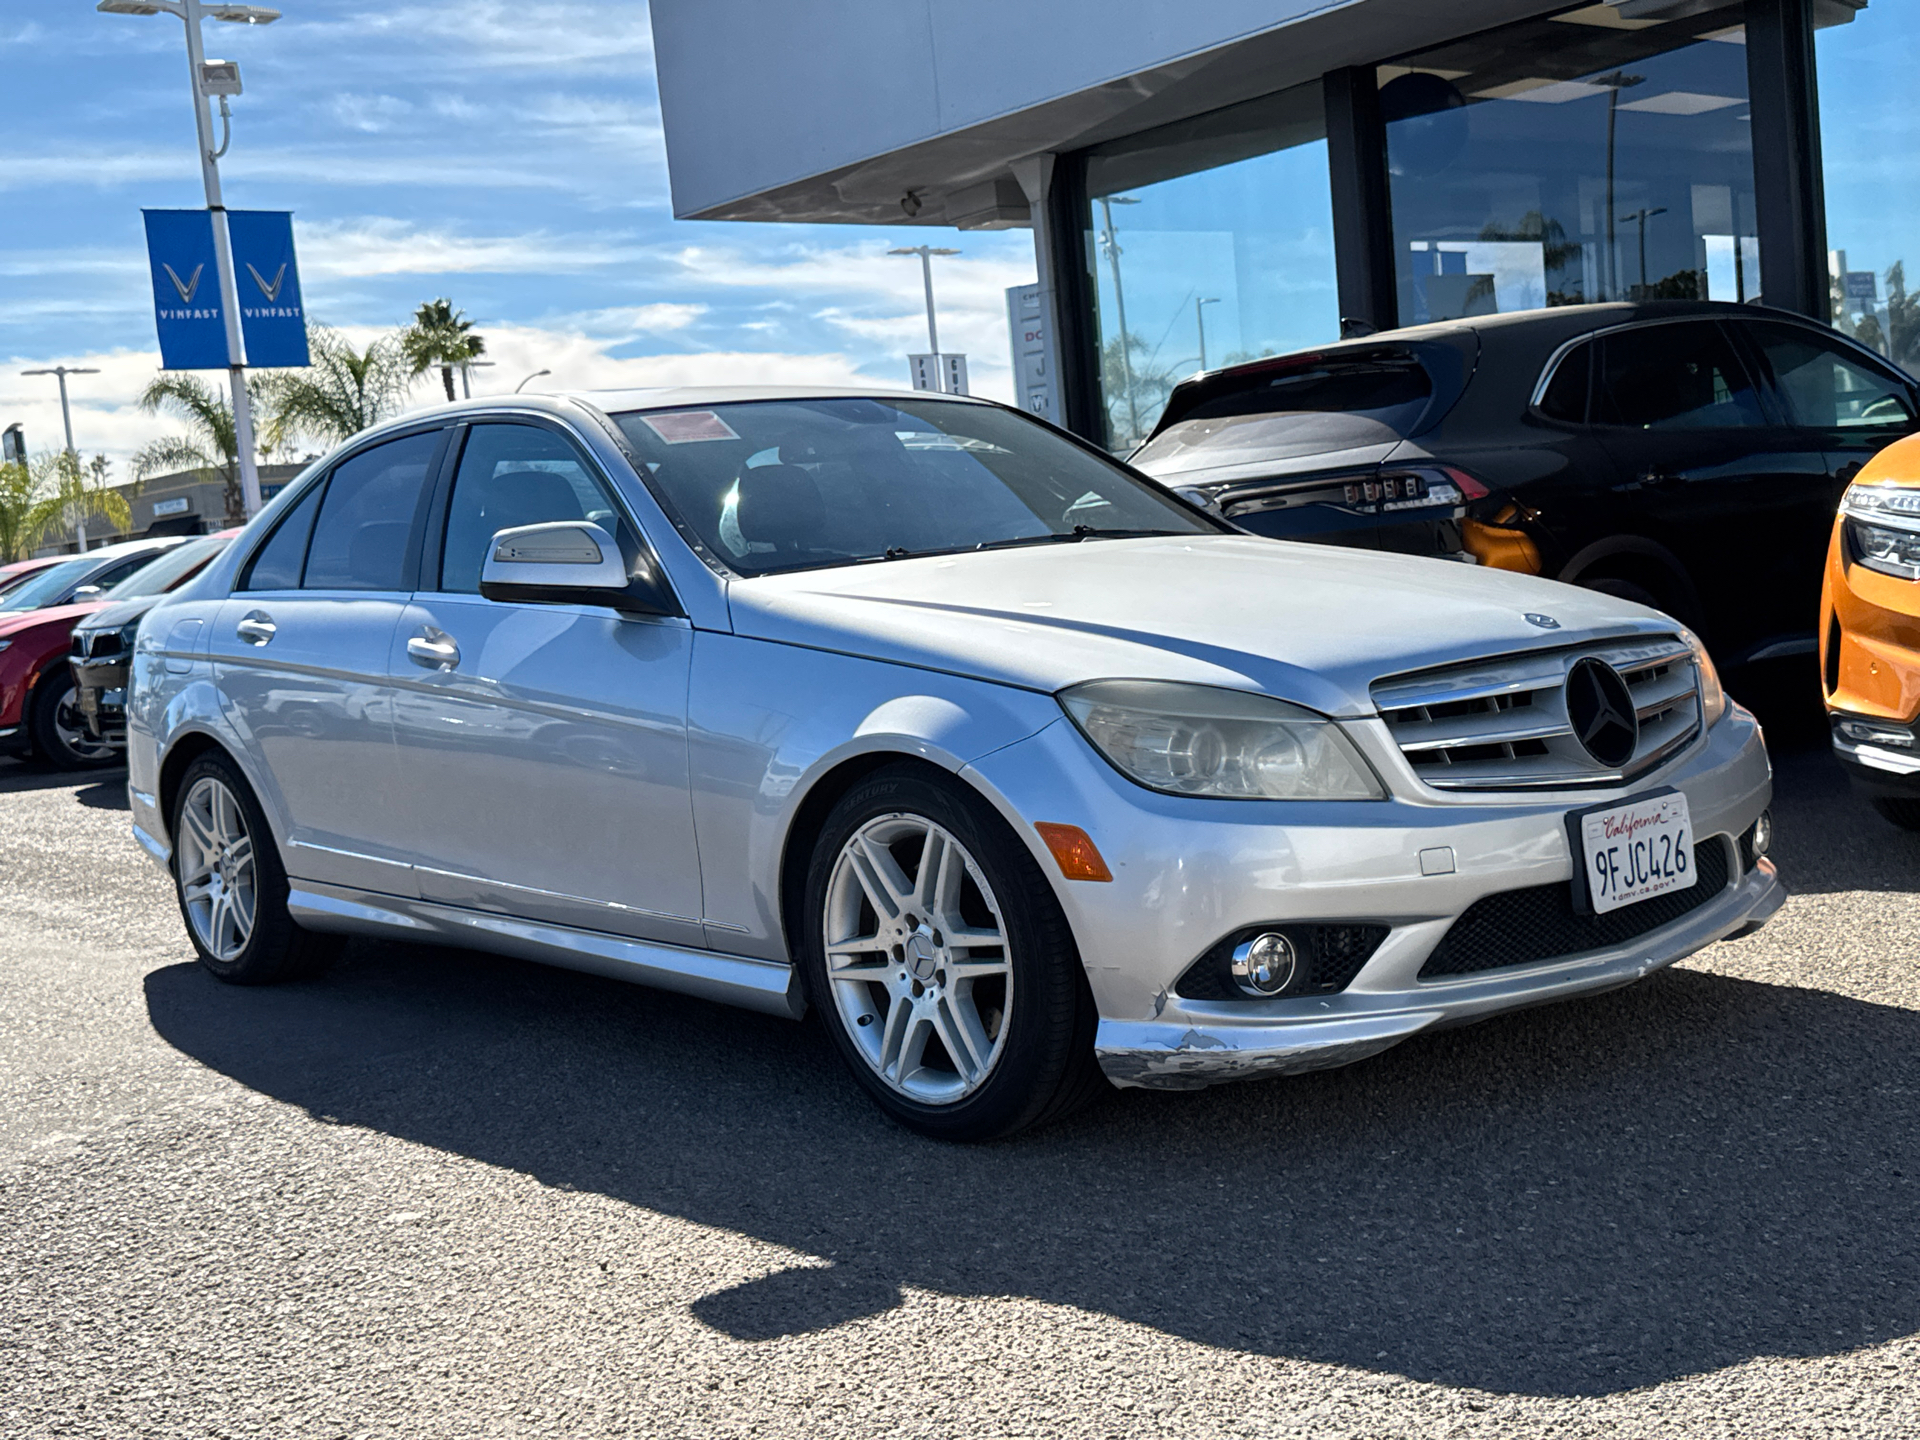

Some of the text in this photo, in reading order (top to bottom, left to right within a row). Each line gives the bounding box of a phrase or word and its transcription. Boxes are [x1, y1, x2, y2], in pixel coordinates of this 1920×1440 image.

[160, 308, 219, 320] VINFAST
[244, 307, 300, 318] VINFAST
[1604, 811, 1669, 840] California
[1595, 829, 1687, 897] 9FJC426
[1618, 880, 1670, 901] dmv.ca.gov
